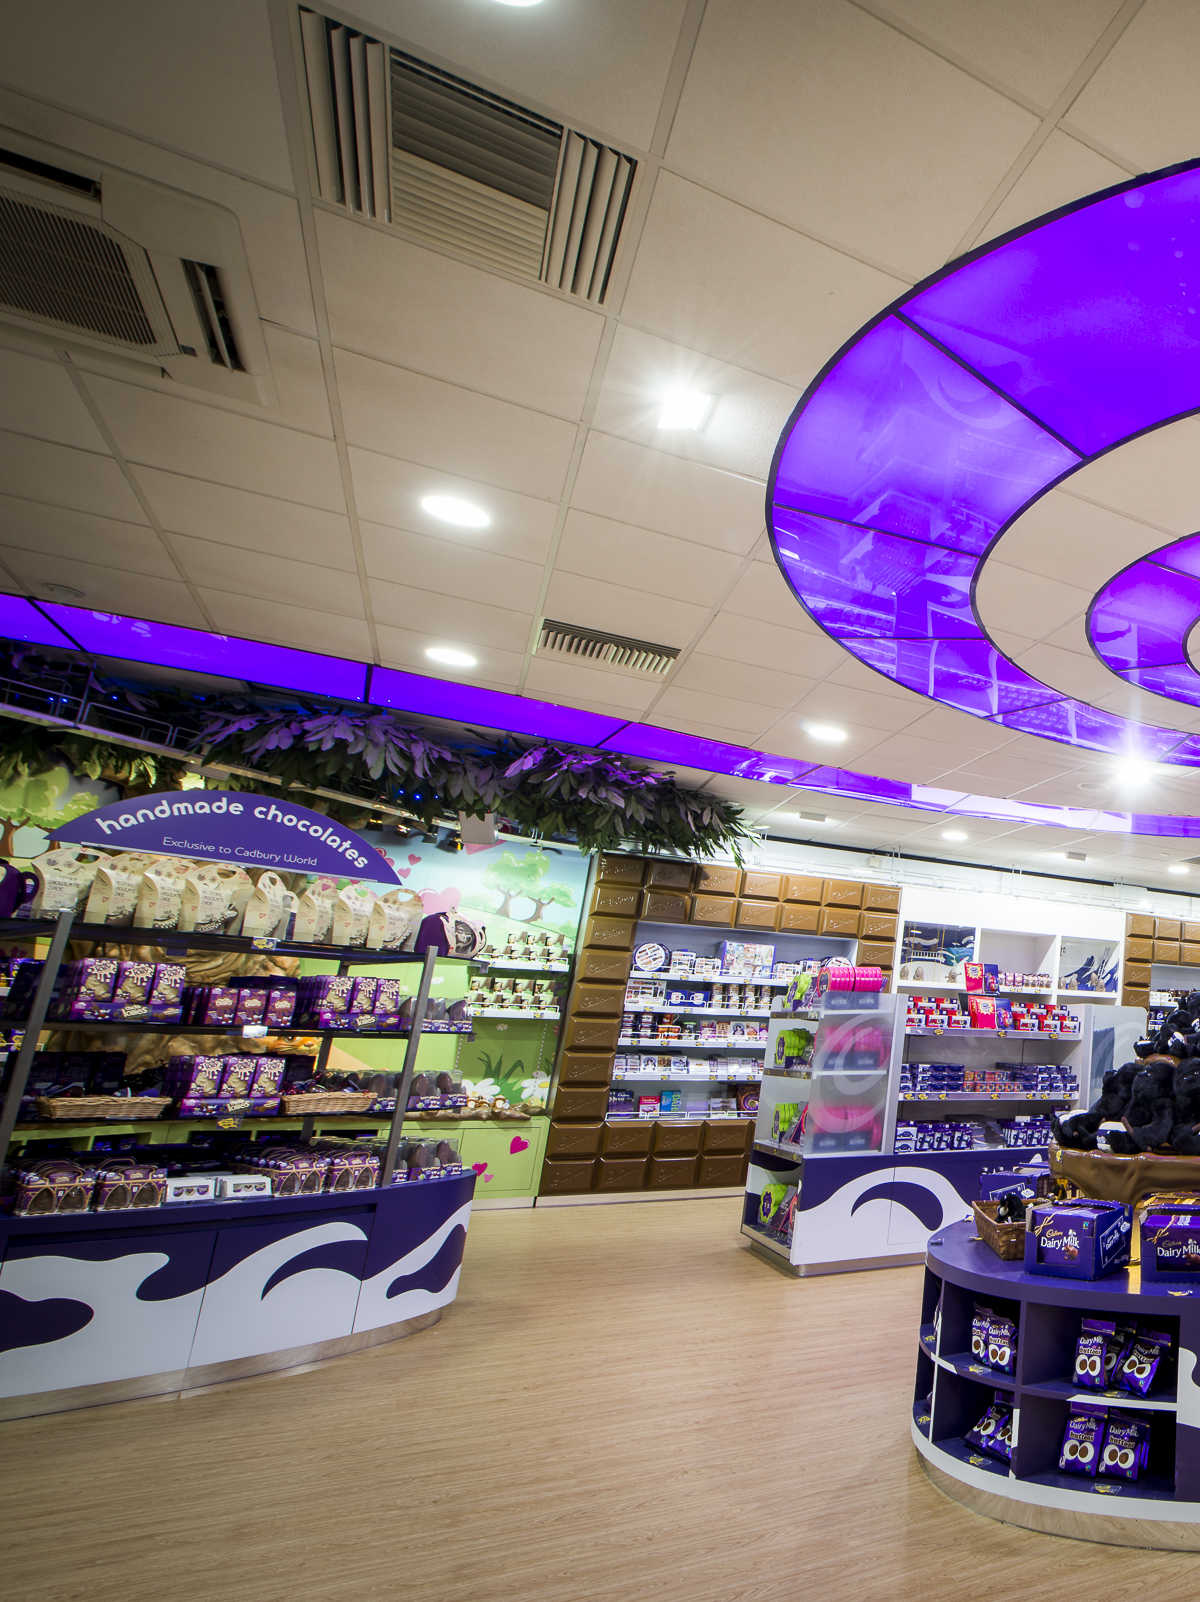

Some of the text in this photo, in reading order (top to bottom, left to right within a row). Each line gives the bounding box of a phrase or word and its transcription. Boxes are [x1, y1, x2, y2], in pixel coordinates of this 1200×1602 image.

[96, 797, 368, 869] handmade chocolates
[163, 837, 317, 866] Exclusive to Cadbury World
[1040, 1237, 1063, 1250] Dairy
[1157, 1247, 1182, 1258] Dairy
